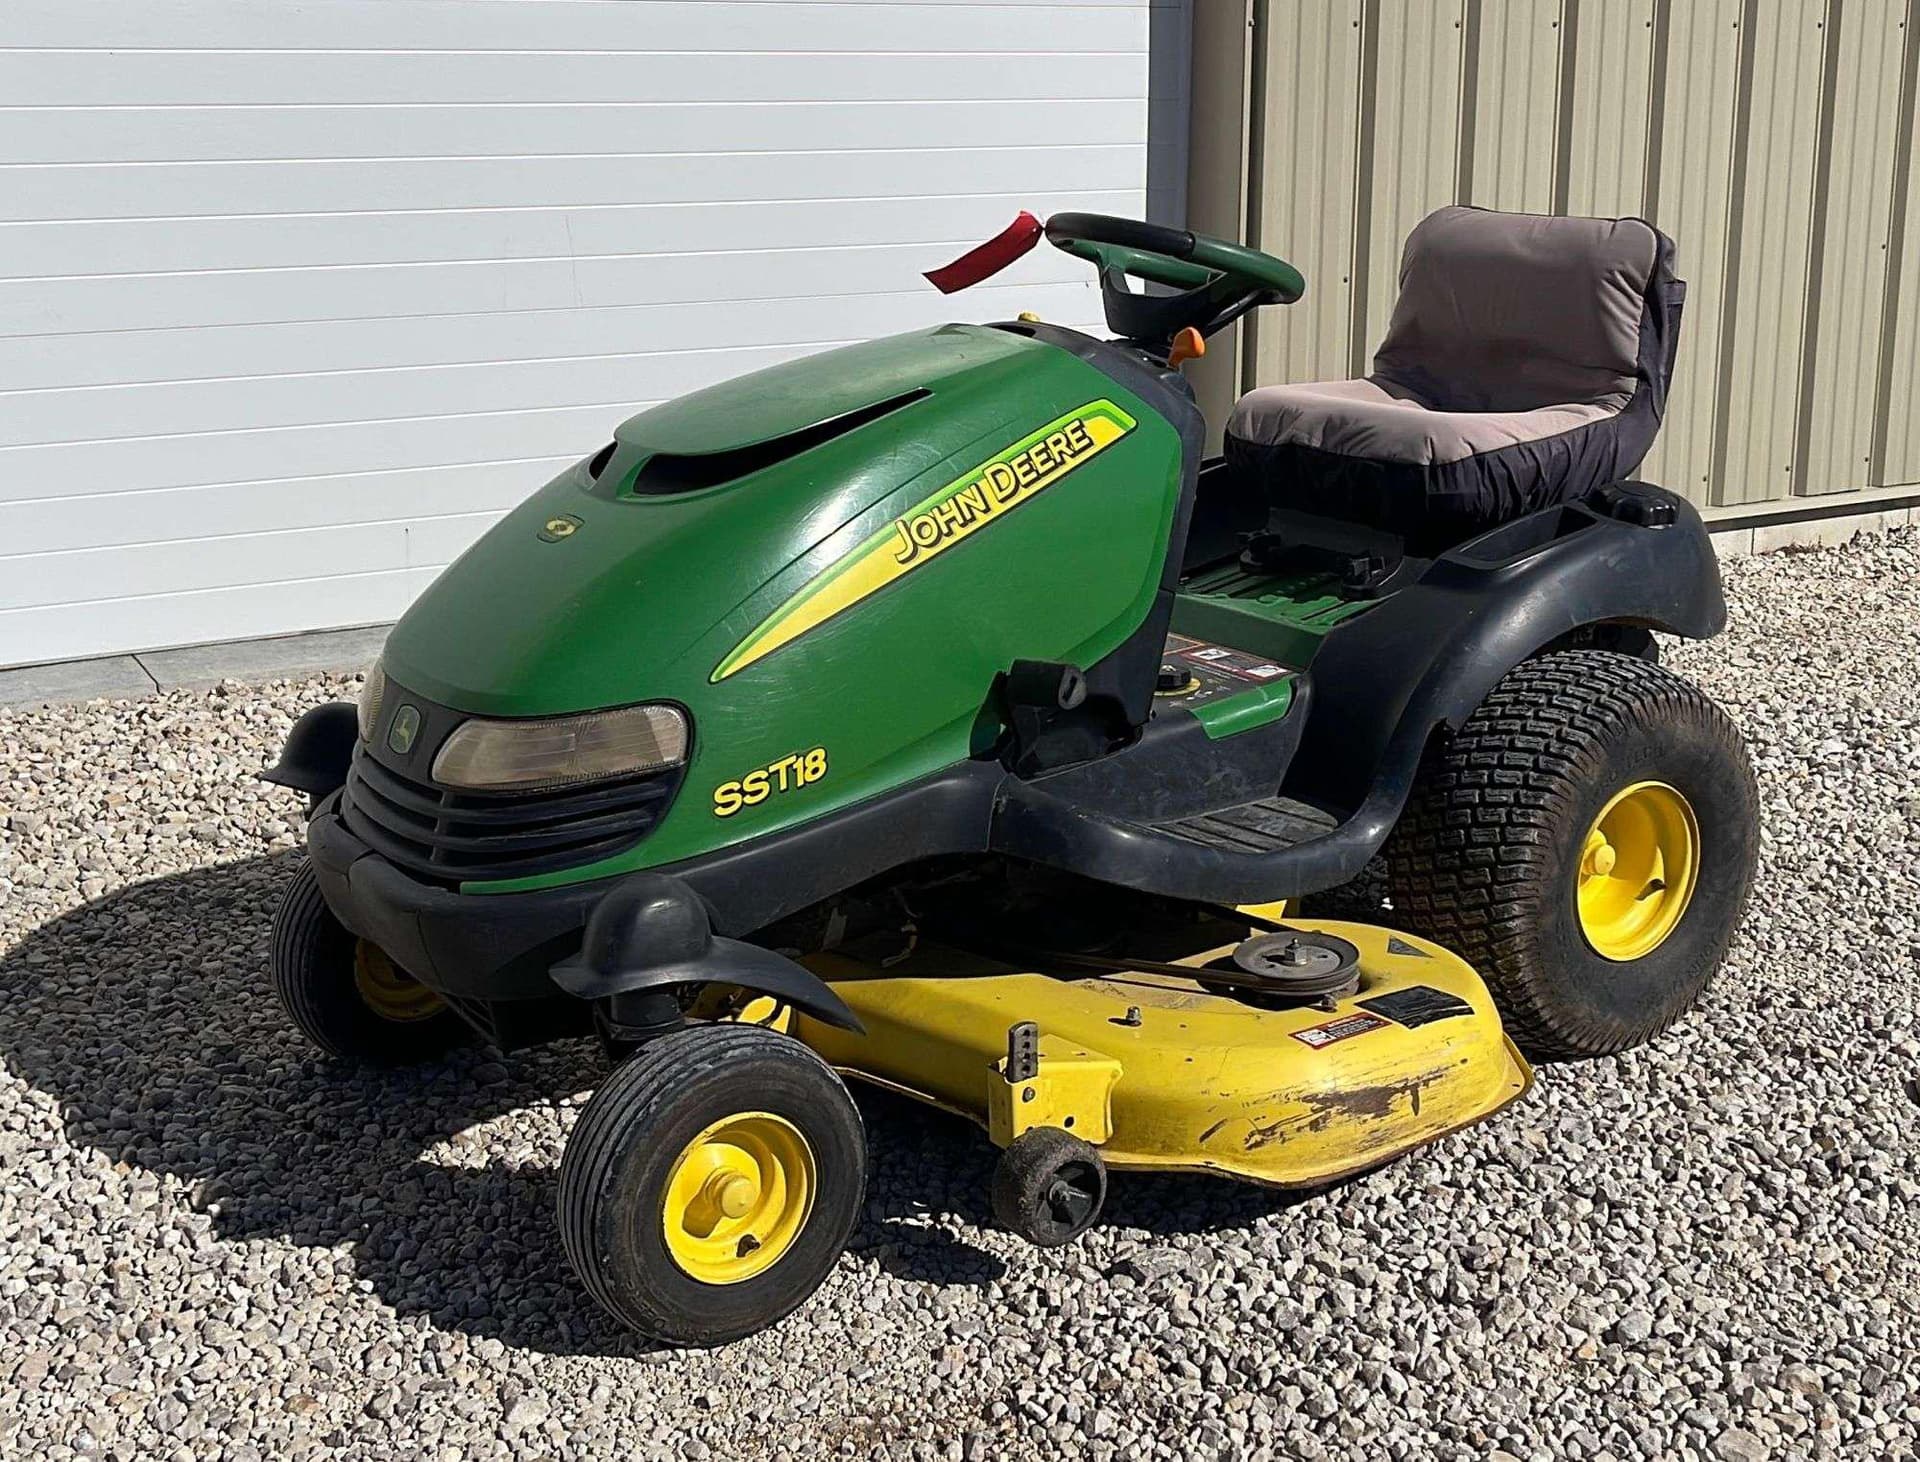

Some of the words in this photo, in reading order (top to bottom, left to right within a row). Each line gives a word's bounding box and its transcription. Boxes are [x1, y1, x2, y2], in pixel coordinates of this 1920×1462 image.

[895, 484, 990, 565] JOHN
[983, 418, 1094, 503] DEERE
[713, 746, 828, 817] SST18
